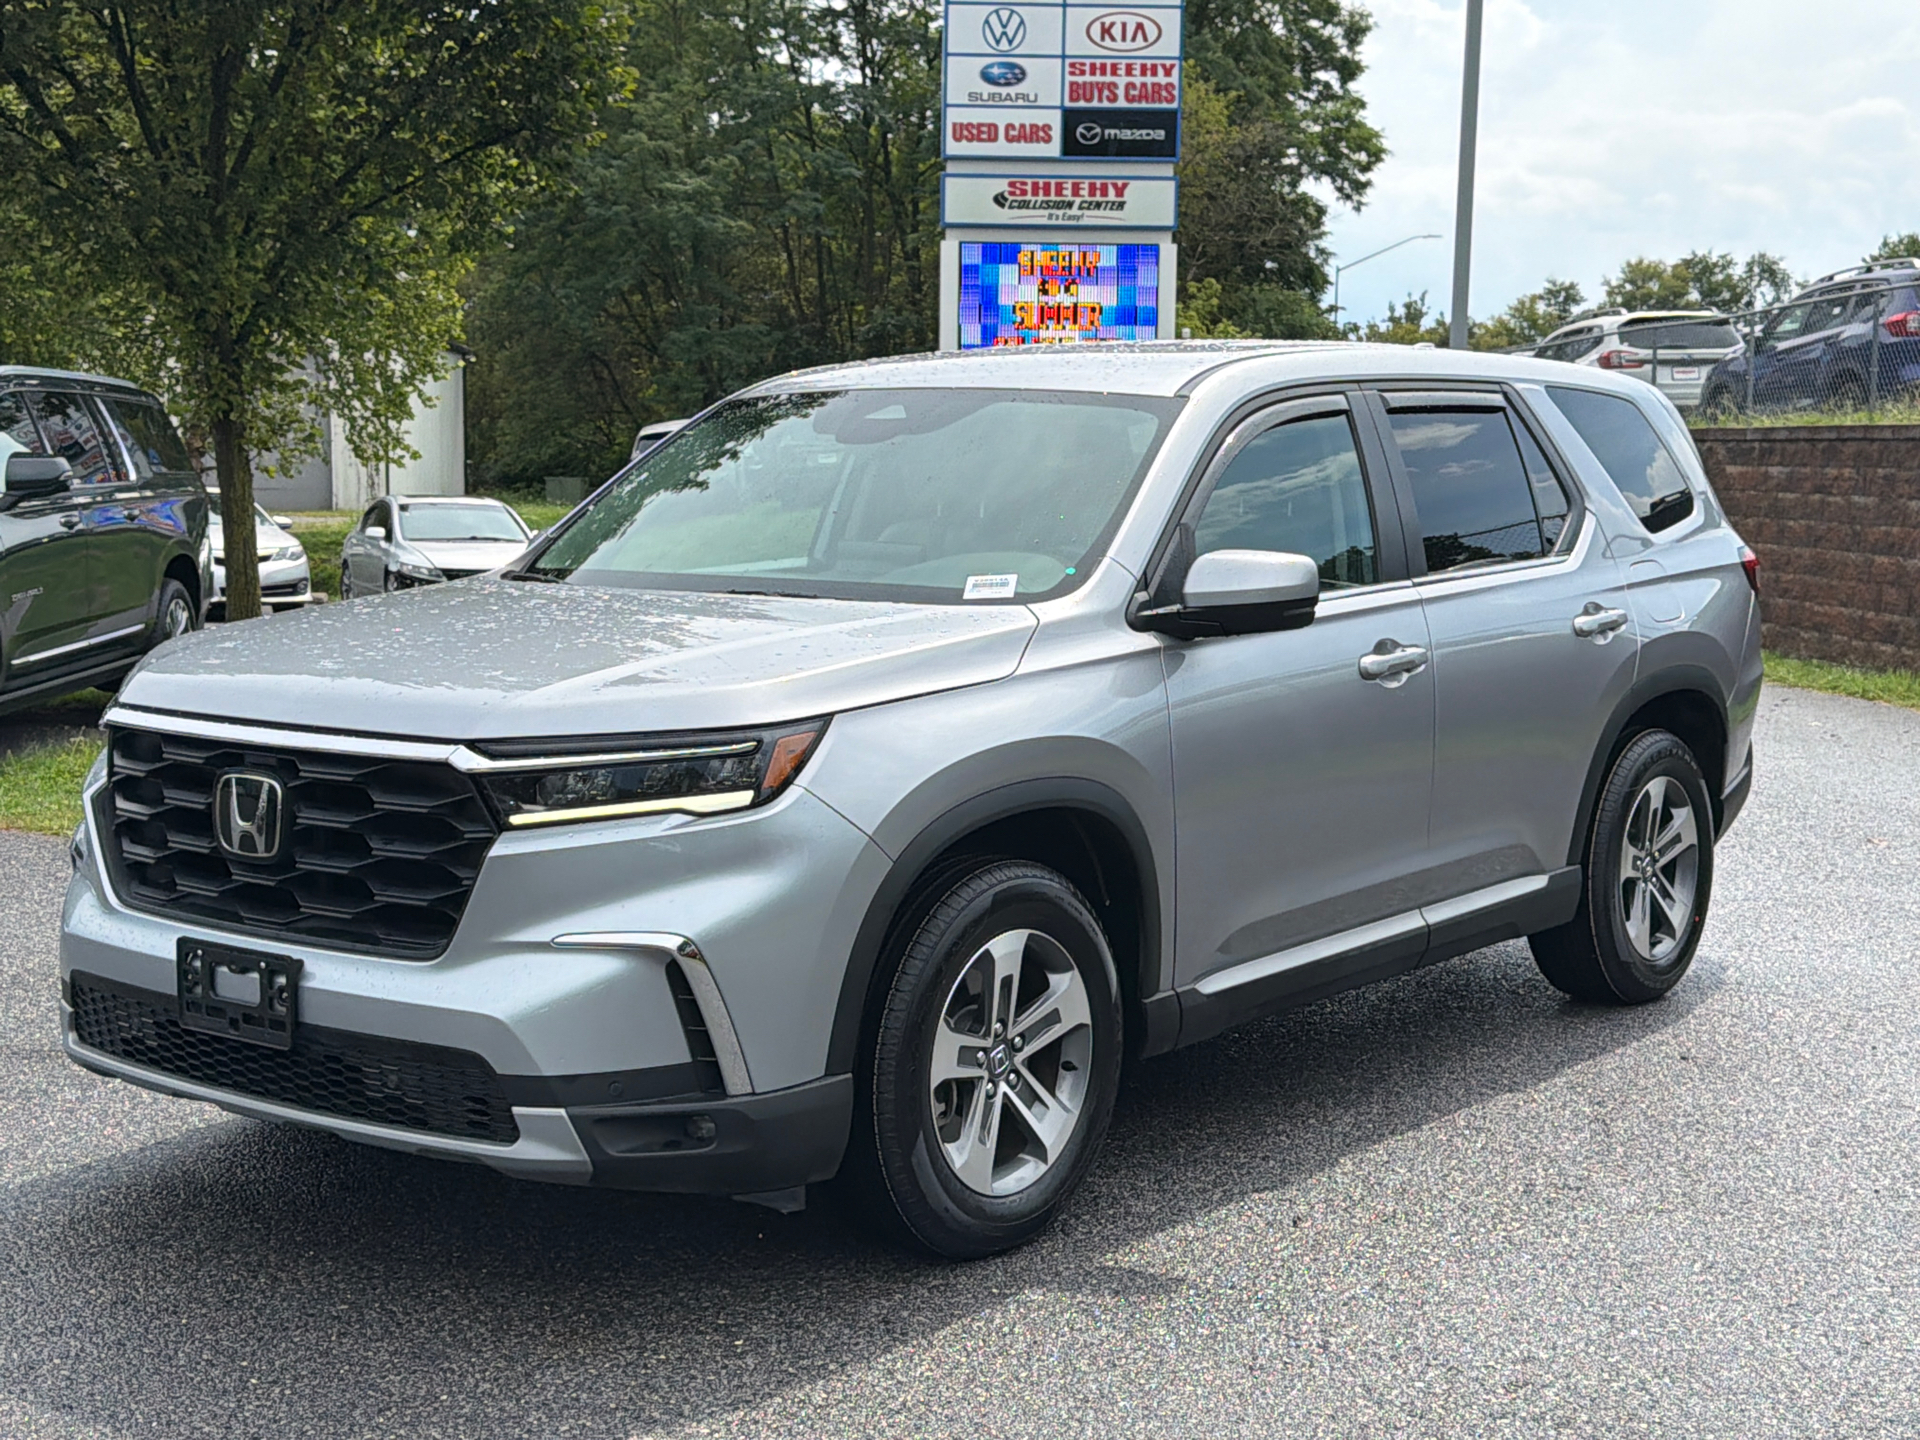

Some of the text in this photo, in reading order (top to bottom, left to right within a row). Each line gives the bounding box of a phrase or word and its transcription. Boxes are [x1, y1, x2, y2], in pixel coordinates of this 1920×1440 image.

[1100, 22, 1149, 43] KIA
[1068, 62, 1176, 77] SHEEHY
[967, 92, 1038, 103] SUBARU
[1068, 80, 1176, 104] BUYS CARS
[952, 122, 1053, 144] USED CARS
[1104, 128, 1166, 141] mazda
[1007, 180, 1130, 198] SHEEHY
[1007, 199, 1127, 211] COLLISION CENTER
